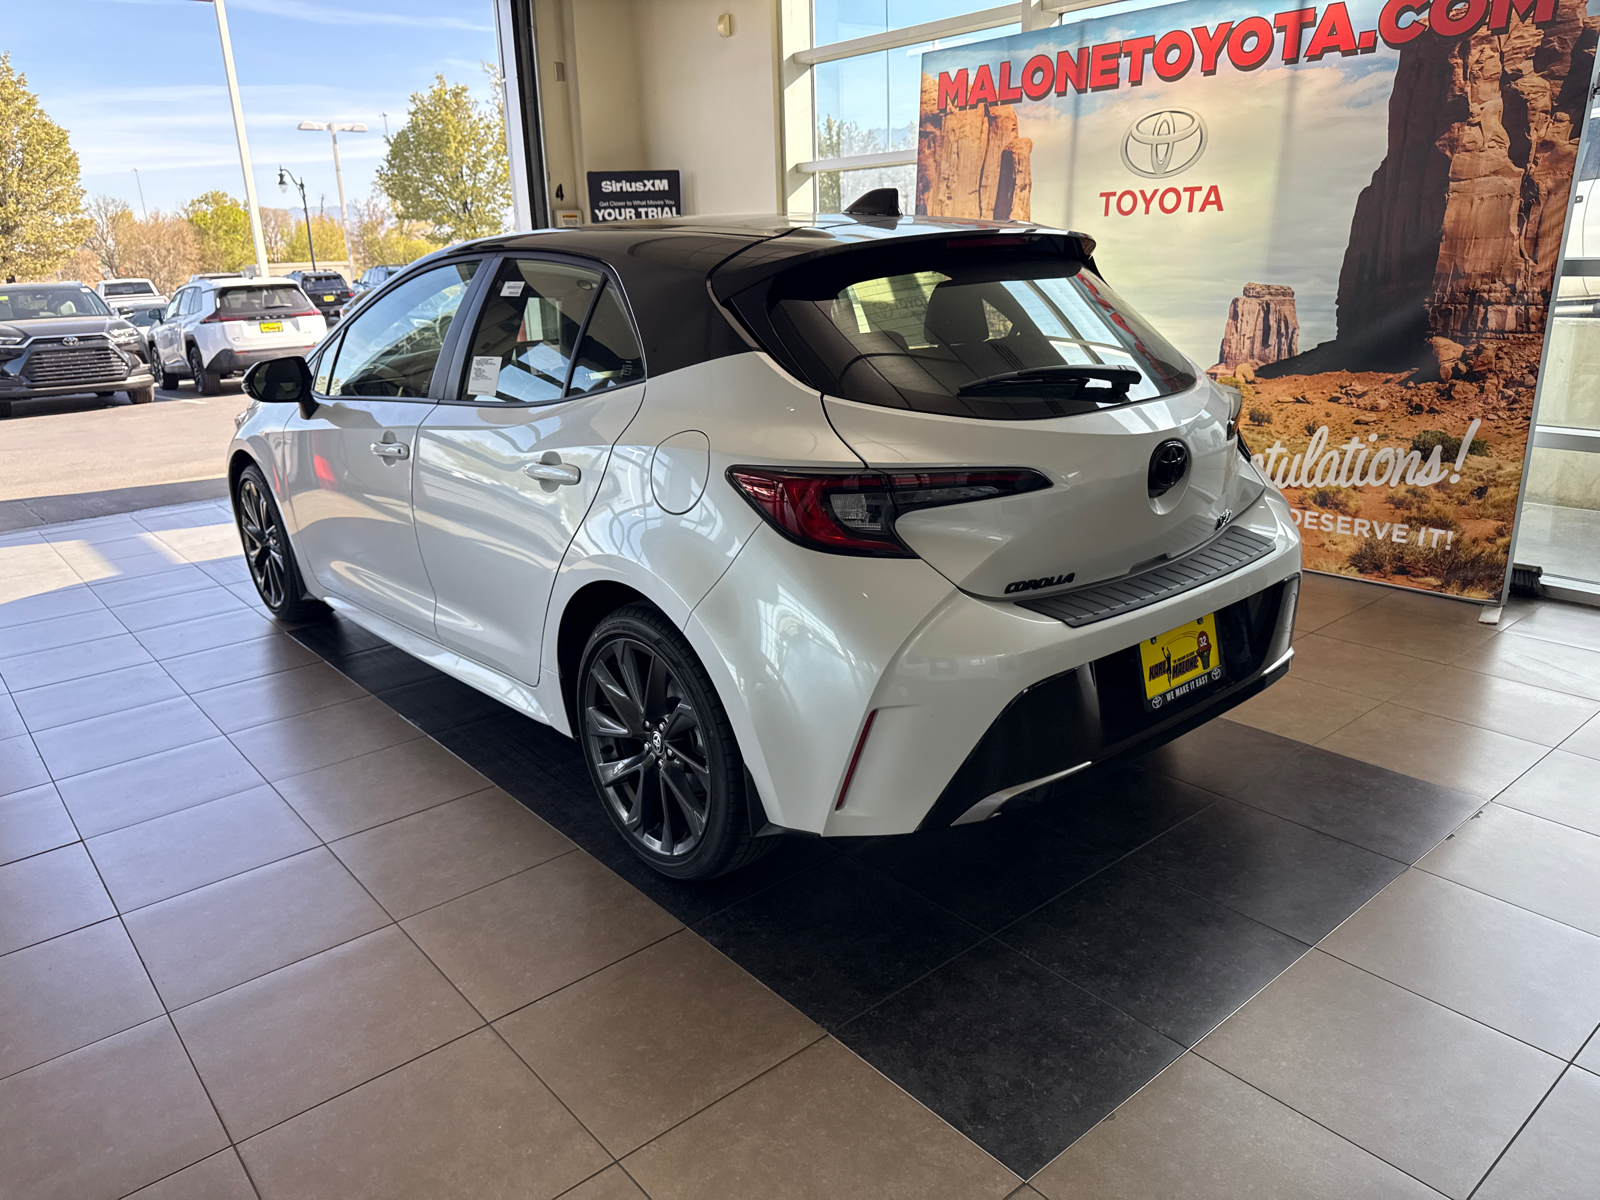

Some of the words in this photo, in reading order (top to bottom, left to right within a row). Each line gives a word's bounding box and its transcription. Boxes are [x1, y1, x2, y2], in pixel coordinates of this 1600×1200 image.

[937, 0, 1557, 113] MALONETOYOTA.COM
[555, 183, 565, 202] 4
[601, 179, 669, 193] SiriusXM
[1099, 185, 1224, 217] TOYOTA
[594, 208, 636, 221] YOUR
[638, 206, 678, 220] TRIAL
[1417, 526, 1454, 551] IT!
[1004, 572, 1075, 595] COROLLA
[1199, 636, 1208, 647] 32
[1172, 655, 1199, 680] MALONE
[1166, 691, 1175, 702] WE
[1175, 683, 1190, 698] MAKE
[1189, 681, 1196, 691] IT
[1195, 674, 1208, 688] EASY
